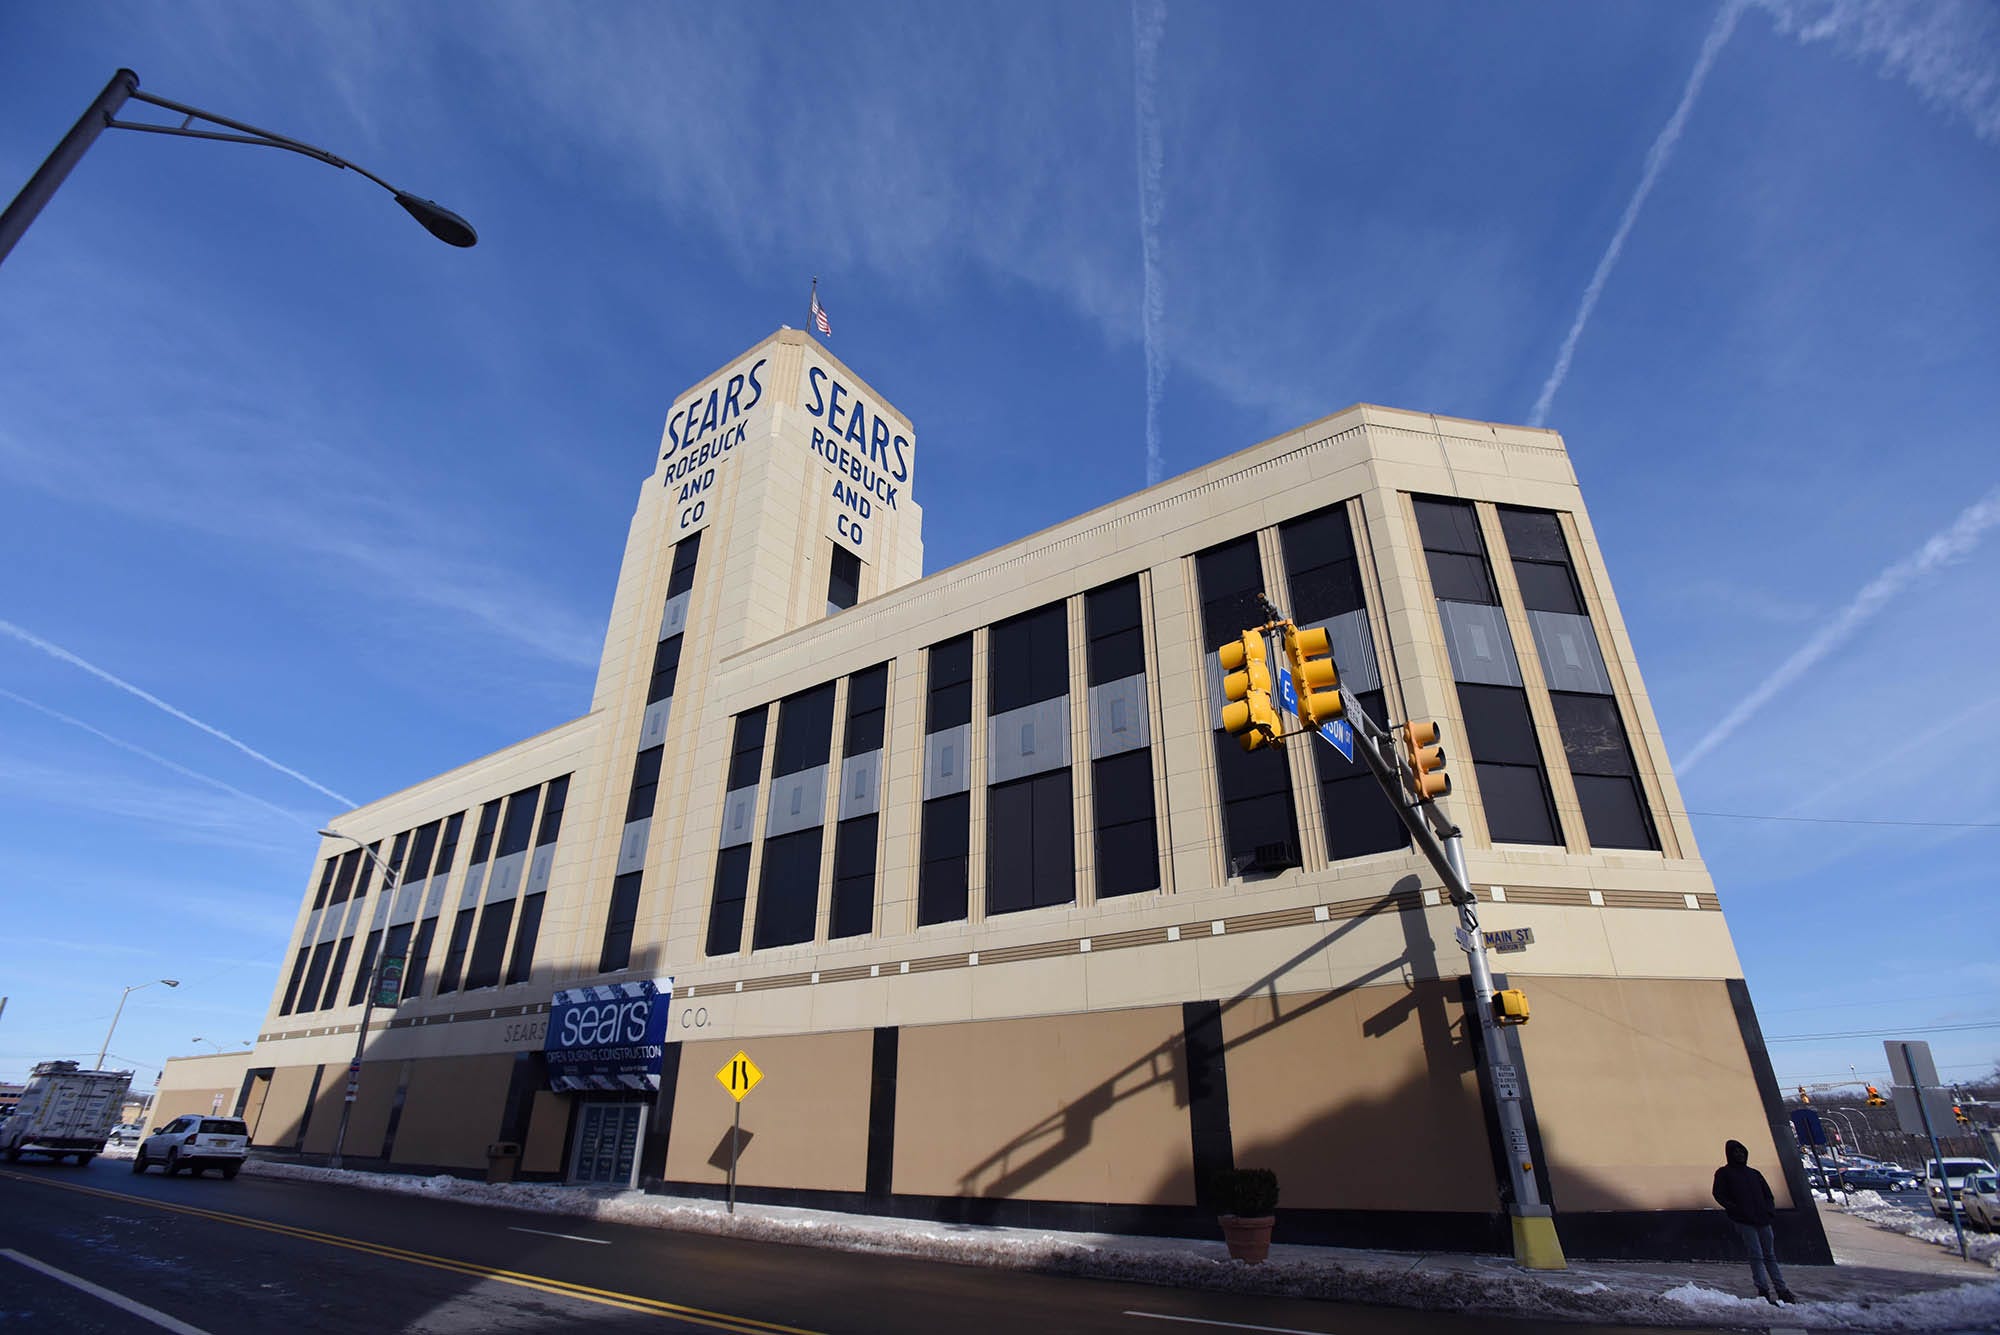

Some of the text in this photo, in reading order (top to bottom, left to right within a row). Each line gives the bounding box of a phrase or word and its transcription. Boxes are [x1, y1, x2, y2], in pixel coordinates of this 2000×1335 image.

[662, 358, 767, 460] SEARS
[805, 366, 909, 483] SEARS
[663, 418, 749, 487] ROEBUCK
[810, 426, 898, 510] ROEBUCK
[678, 468, 715, 504] AND
[832, 480, 871, 519] AND
[680, 500, 705, 529] CO
[837, 513, 863, 545] CO
[1284, 680, 1295, 704] E.
[1323, 720, 1344, 744] SON
[1485, 931, 1513, 945] MAIN
[1516, 928, 1529, 941] ST
[504, 1022, 547, 1043] SEARS
[561, 1001, 648, 1047] sears
[681, 1007, 712, 1028] CO.
[546, 1045, 662, 1063] OPEN DURING CONSTRUCTION
